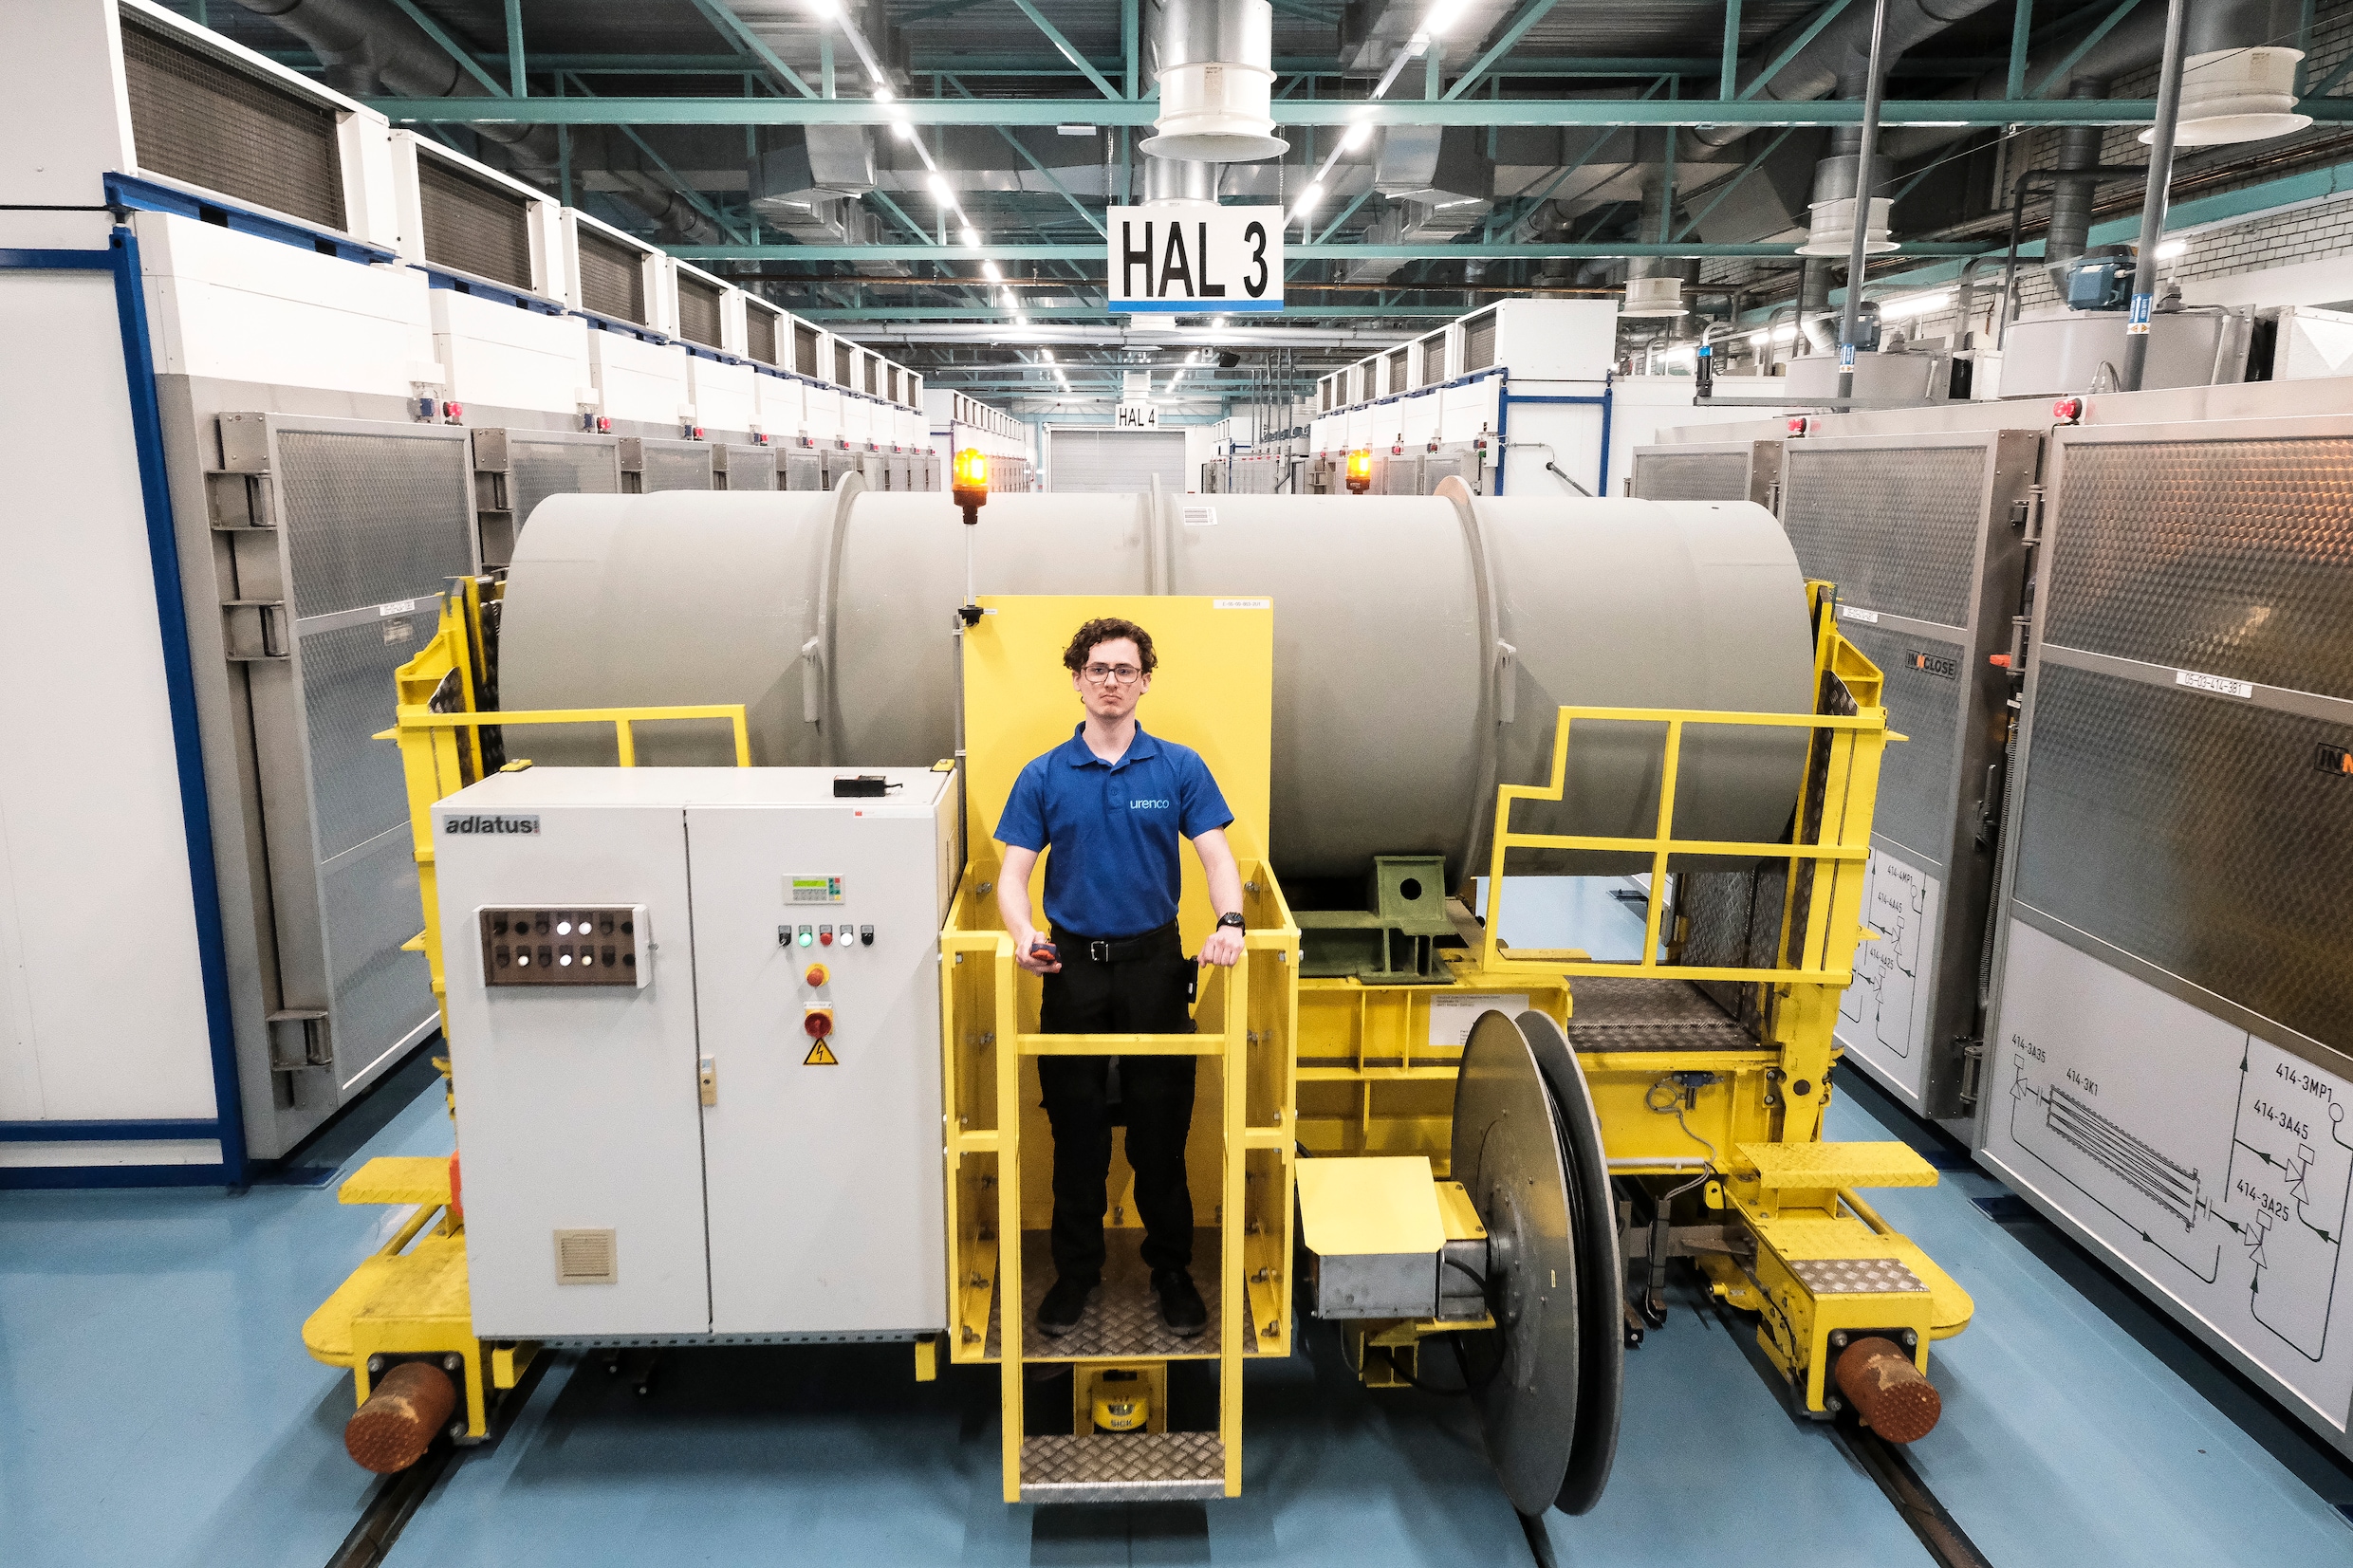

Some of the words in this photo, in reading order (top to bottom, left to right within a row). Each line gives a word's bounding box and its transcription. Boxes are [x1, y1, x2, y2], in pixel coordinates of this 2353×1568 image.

[1122, 221, 1225, 297] HAL
[1243, 221, 1269, 298] 3
[1120, 408, 1144, 426] HAL
[1148, 408, 1156, 427] 4
[1130, 800, 1170, 809] urenco
[446, 816, 532, 834] adlatus
[1887, 864, 1913, 886] 414-4MP1
[1878, 892, 1903, 913] 414-4A45
[1869, 948, 1894, 970] 414-4A25
[2011, 1034, 2046, 1063] 414-3A35
[2066, 1067, 2099, 1098] 414-3K1
[2276, 1062, 2333, 1103] 414-3MP1
[2253, 1099, 2309, 1140] 414-3A45
[2236, 1179, 2289, 1222] 414-3A25
